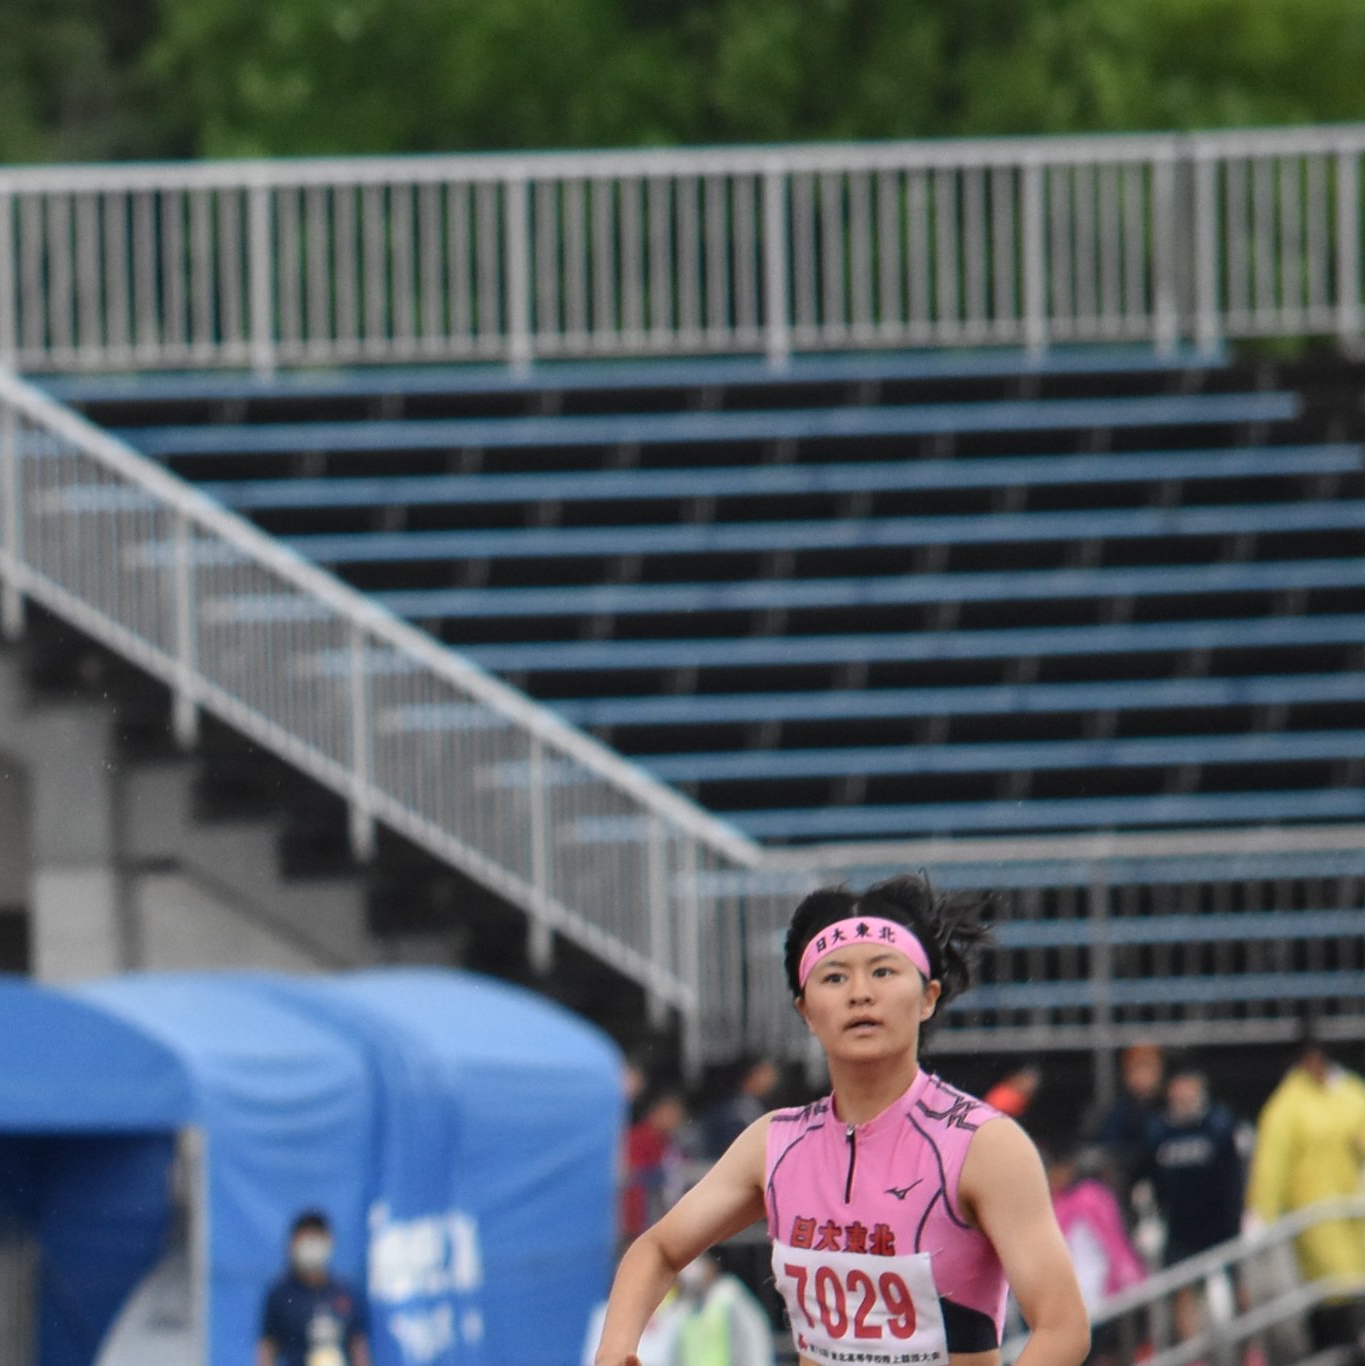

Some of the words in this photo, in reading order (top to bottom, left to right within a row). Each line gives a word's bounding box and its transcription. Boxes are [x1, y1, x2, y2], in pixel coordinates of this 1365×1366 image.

[816, 922, 895, 953] 日大東北
[790, 1216, 895, 1257] 日大東北
[784, 1263, 917, 1340] 7029
